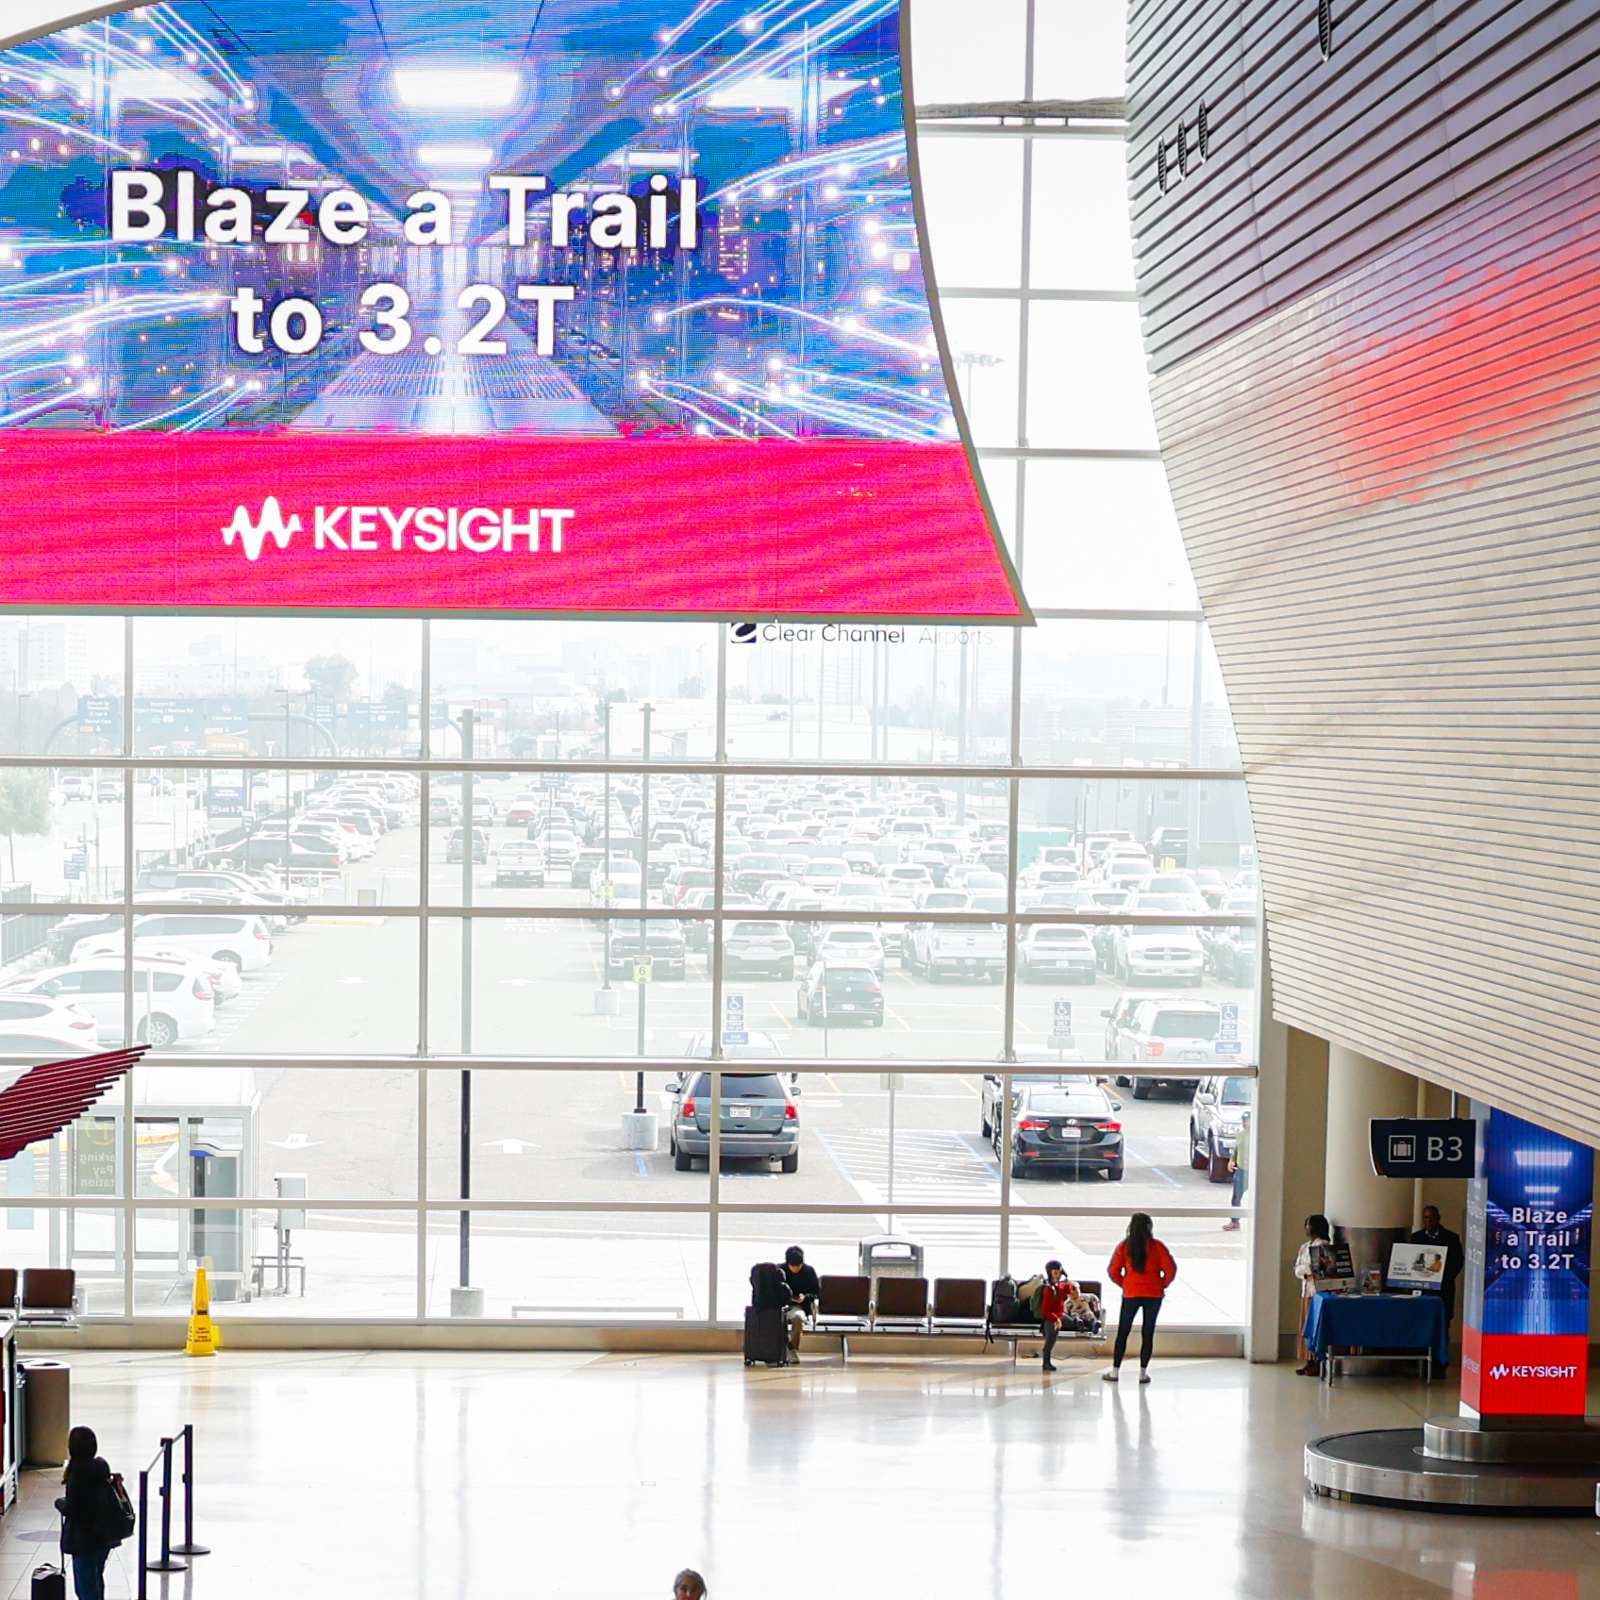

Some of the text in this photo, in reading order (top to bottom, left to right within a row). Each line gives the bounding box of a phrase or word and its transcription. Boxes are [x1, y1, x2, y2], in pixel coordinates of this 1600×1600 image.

[111, 170, 697, 248] Blaze a Trail
[231, 282, 575, 356] to 3.2T
[315, 505, 575, 552] KEYSIGHT
[762, 624, 993, 647] Clear Channel Airports
[604, 886, 610, 894] 6
[639, 966, 646, 976] 6
[1427, 1136, 1463, 1162] B3
[1512, 1207, 1568, 1224] Blaze
[1507, 1230, 1570, 1246] a Trail
[1501, 1253, 1575, 1270] to 3.2T
[1512, 1365, 1578, 1378] KEYSIGHT
